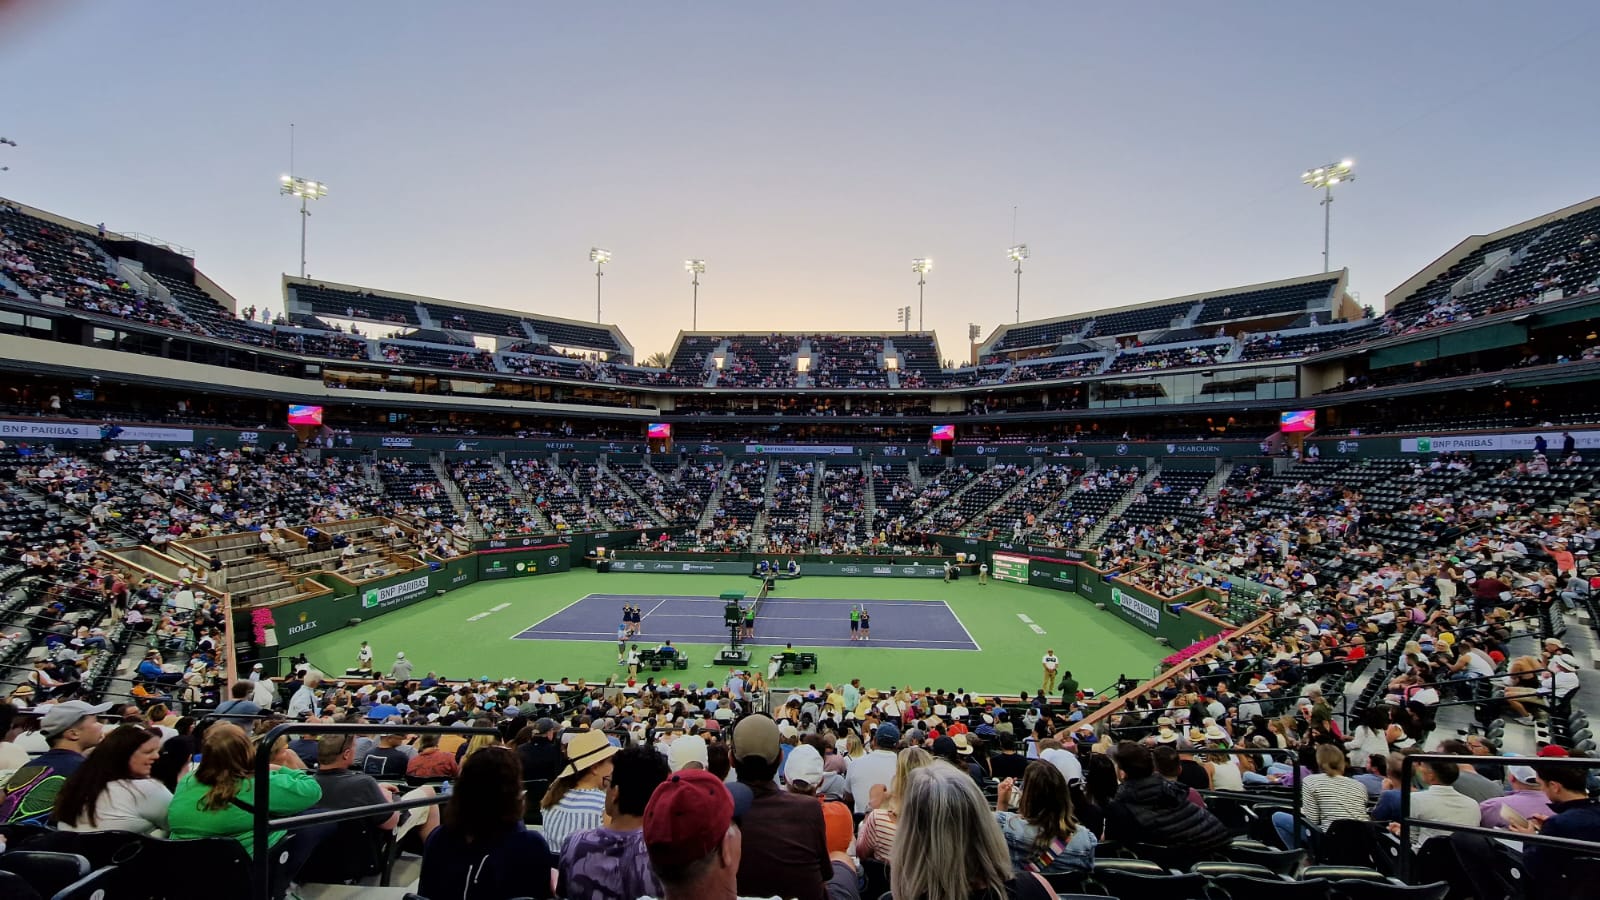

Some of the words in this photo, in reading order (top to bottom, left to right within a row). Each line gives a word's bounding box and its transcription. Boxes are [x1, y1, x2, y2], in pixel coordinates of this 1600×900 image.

[2, 425, 28, 433] BNP
[31, 426, 79, 435] PARIBAS
[1432, 440, 1451, 448] BNP
[1453, 439, 1493, 447] PARIBAS
[380, 586, 395, 600] BNP
[398, 579, 427, 594] PARIBAS
[1121, 594, 1134, 606] BNP
[1133, 600, 1158, 620] PARIBAS
[288, 620, 318, 635] ROLEX
